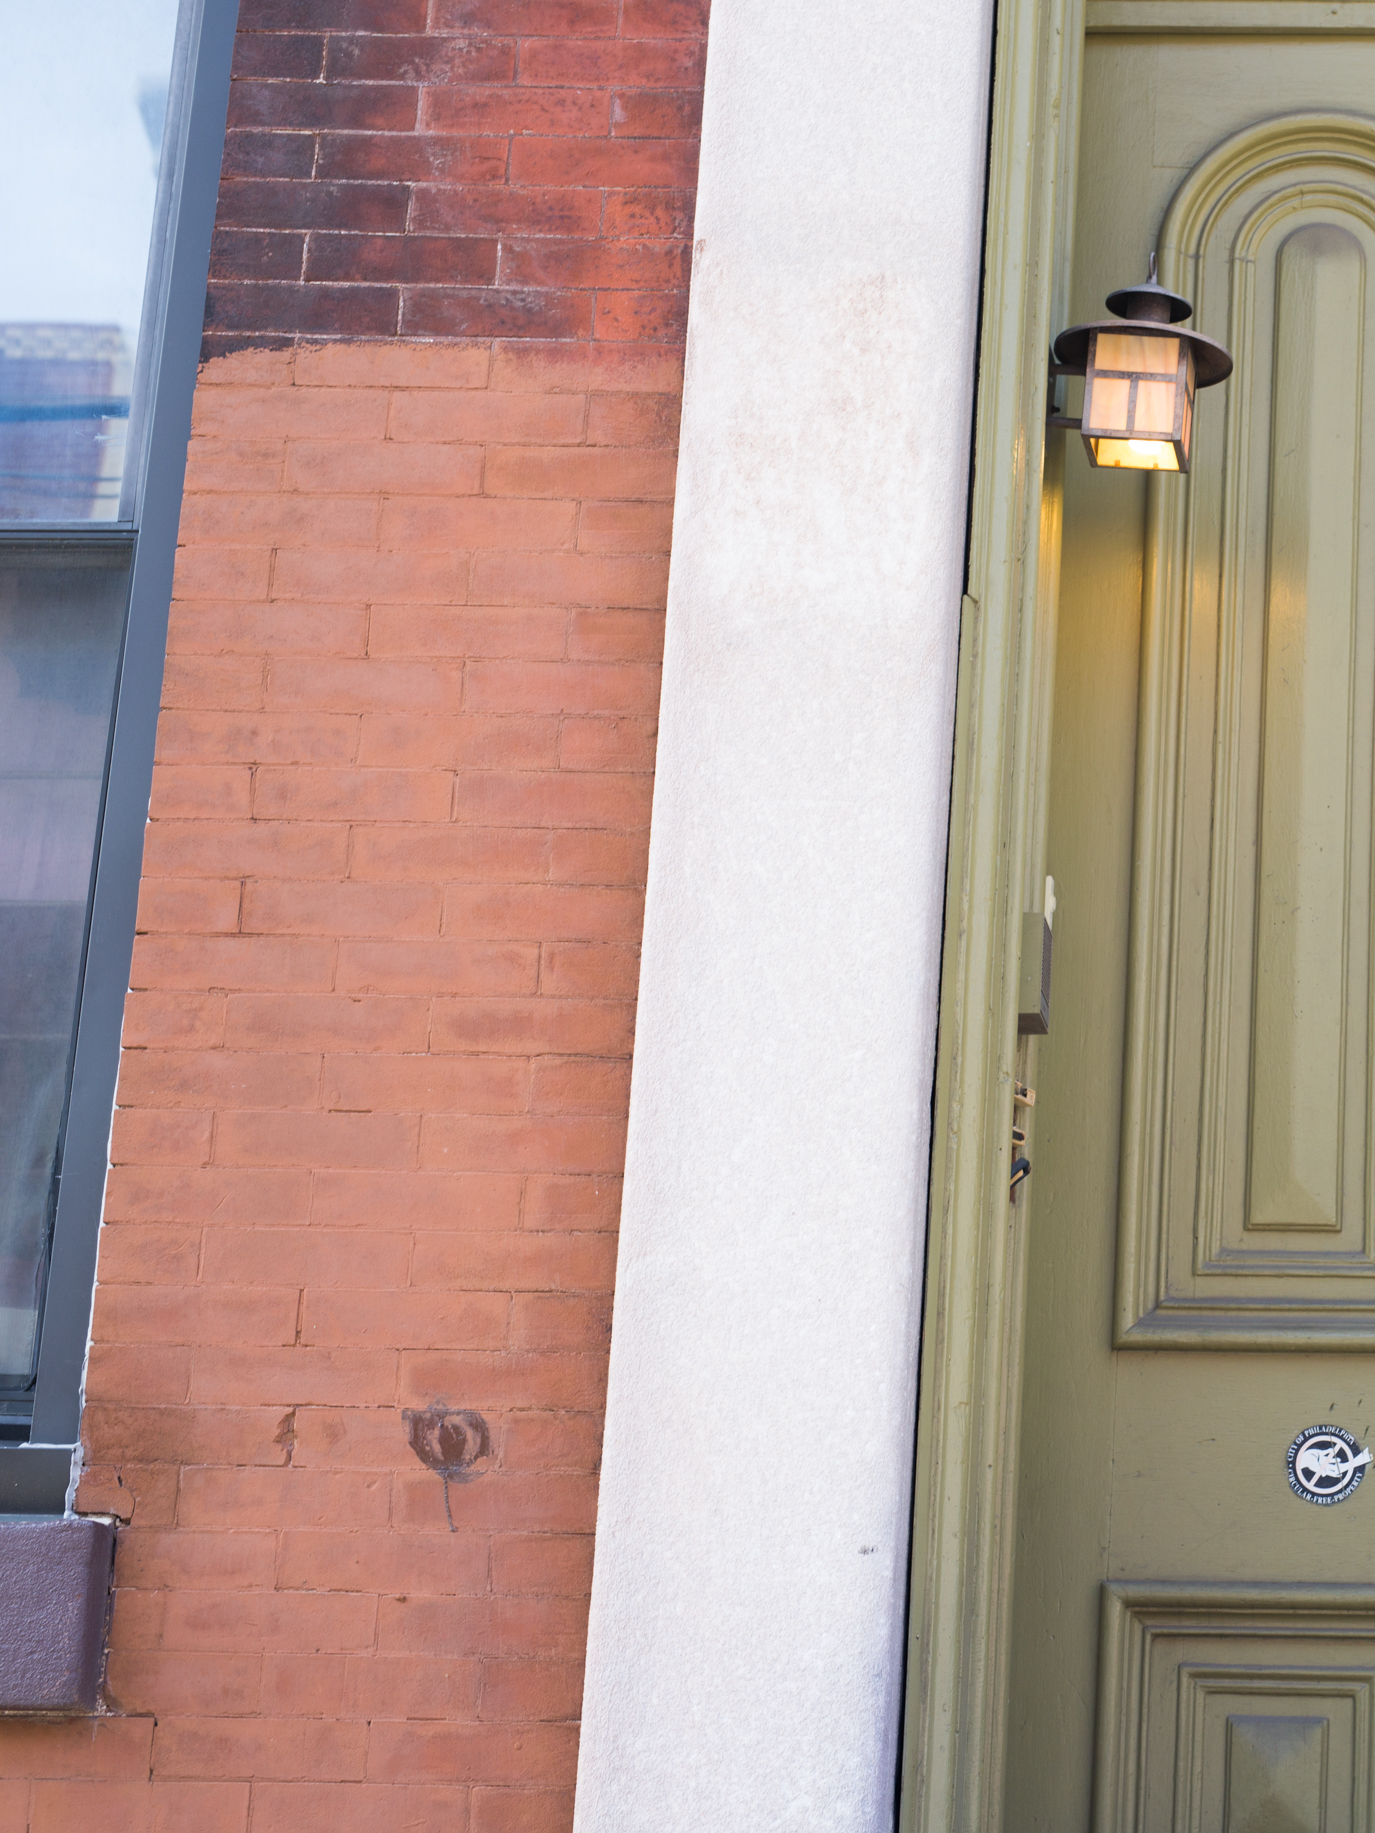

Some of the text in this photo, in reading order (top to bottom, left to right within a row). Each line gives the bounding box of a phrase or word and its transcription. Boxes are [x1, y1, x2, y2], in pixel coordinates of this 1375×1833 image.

[1287, 1425, 1355, 1462] CITY OF PHILADELPHIA
